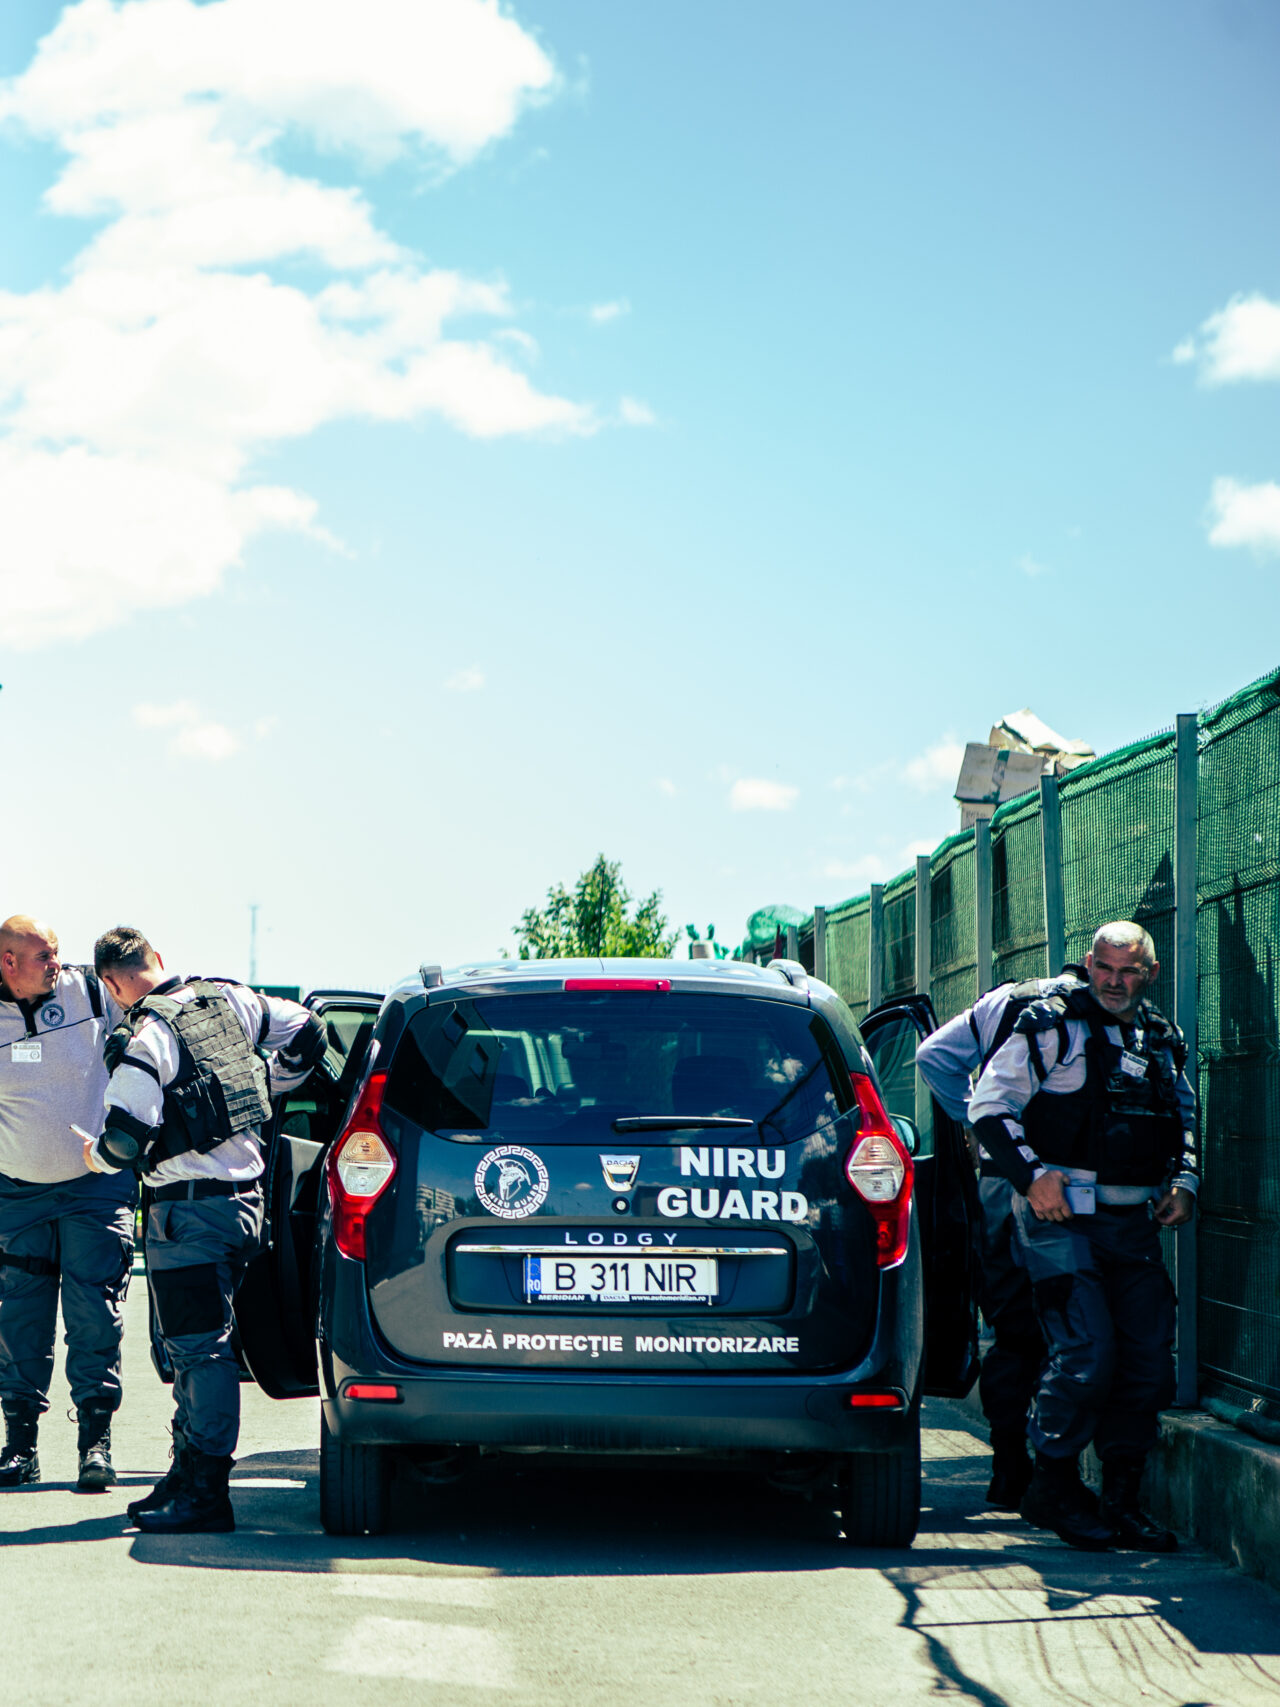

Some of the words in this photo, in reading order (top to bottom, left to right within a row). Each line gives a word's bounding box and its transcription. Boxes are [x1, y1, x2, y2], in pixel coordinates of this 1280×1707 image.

[680, 1146, 786, 1179] NIRU
[488, 1192, 510, 1209] NIRU
[513, 1183, 539, 1209] GUARD
[657, 1187, 809, 1221] GUARD
[565, 1231, 678, 1246] LODGY
[527, 1279, 541, 1292] RO
[555, 1263, 576, 1291] B
[590, 1262, 630, 1292] 311
[644, 1262, 697, 1293] NIR
[634, 1335, 800, 1353] MONITORIZARE
